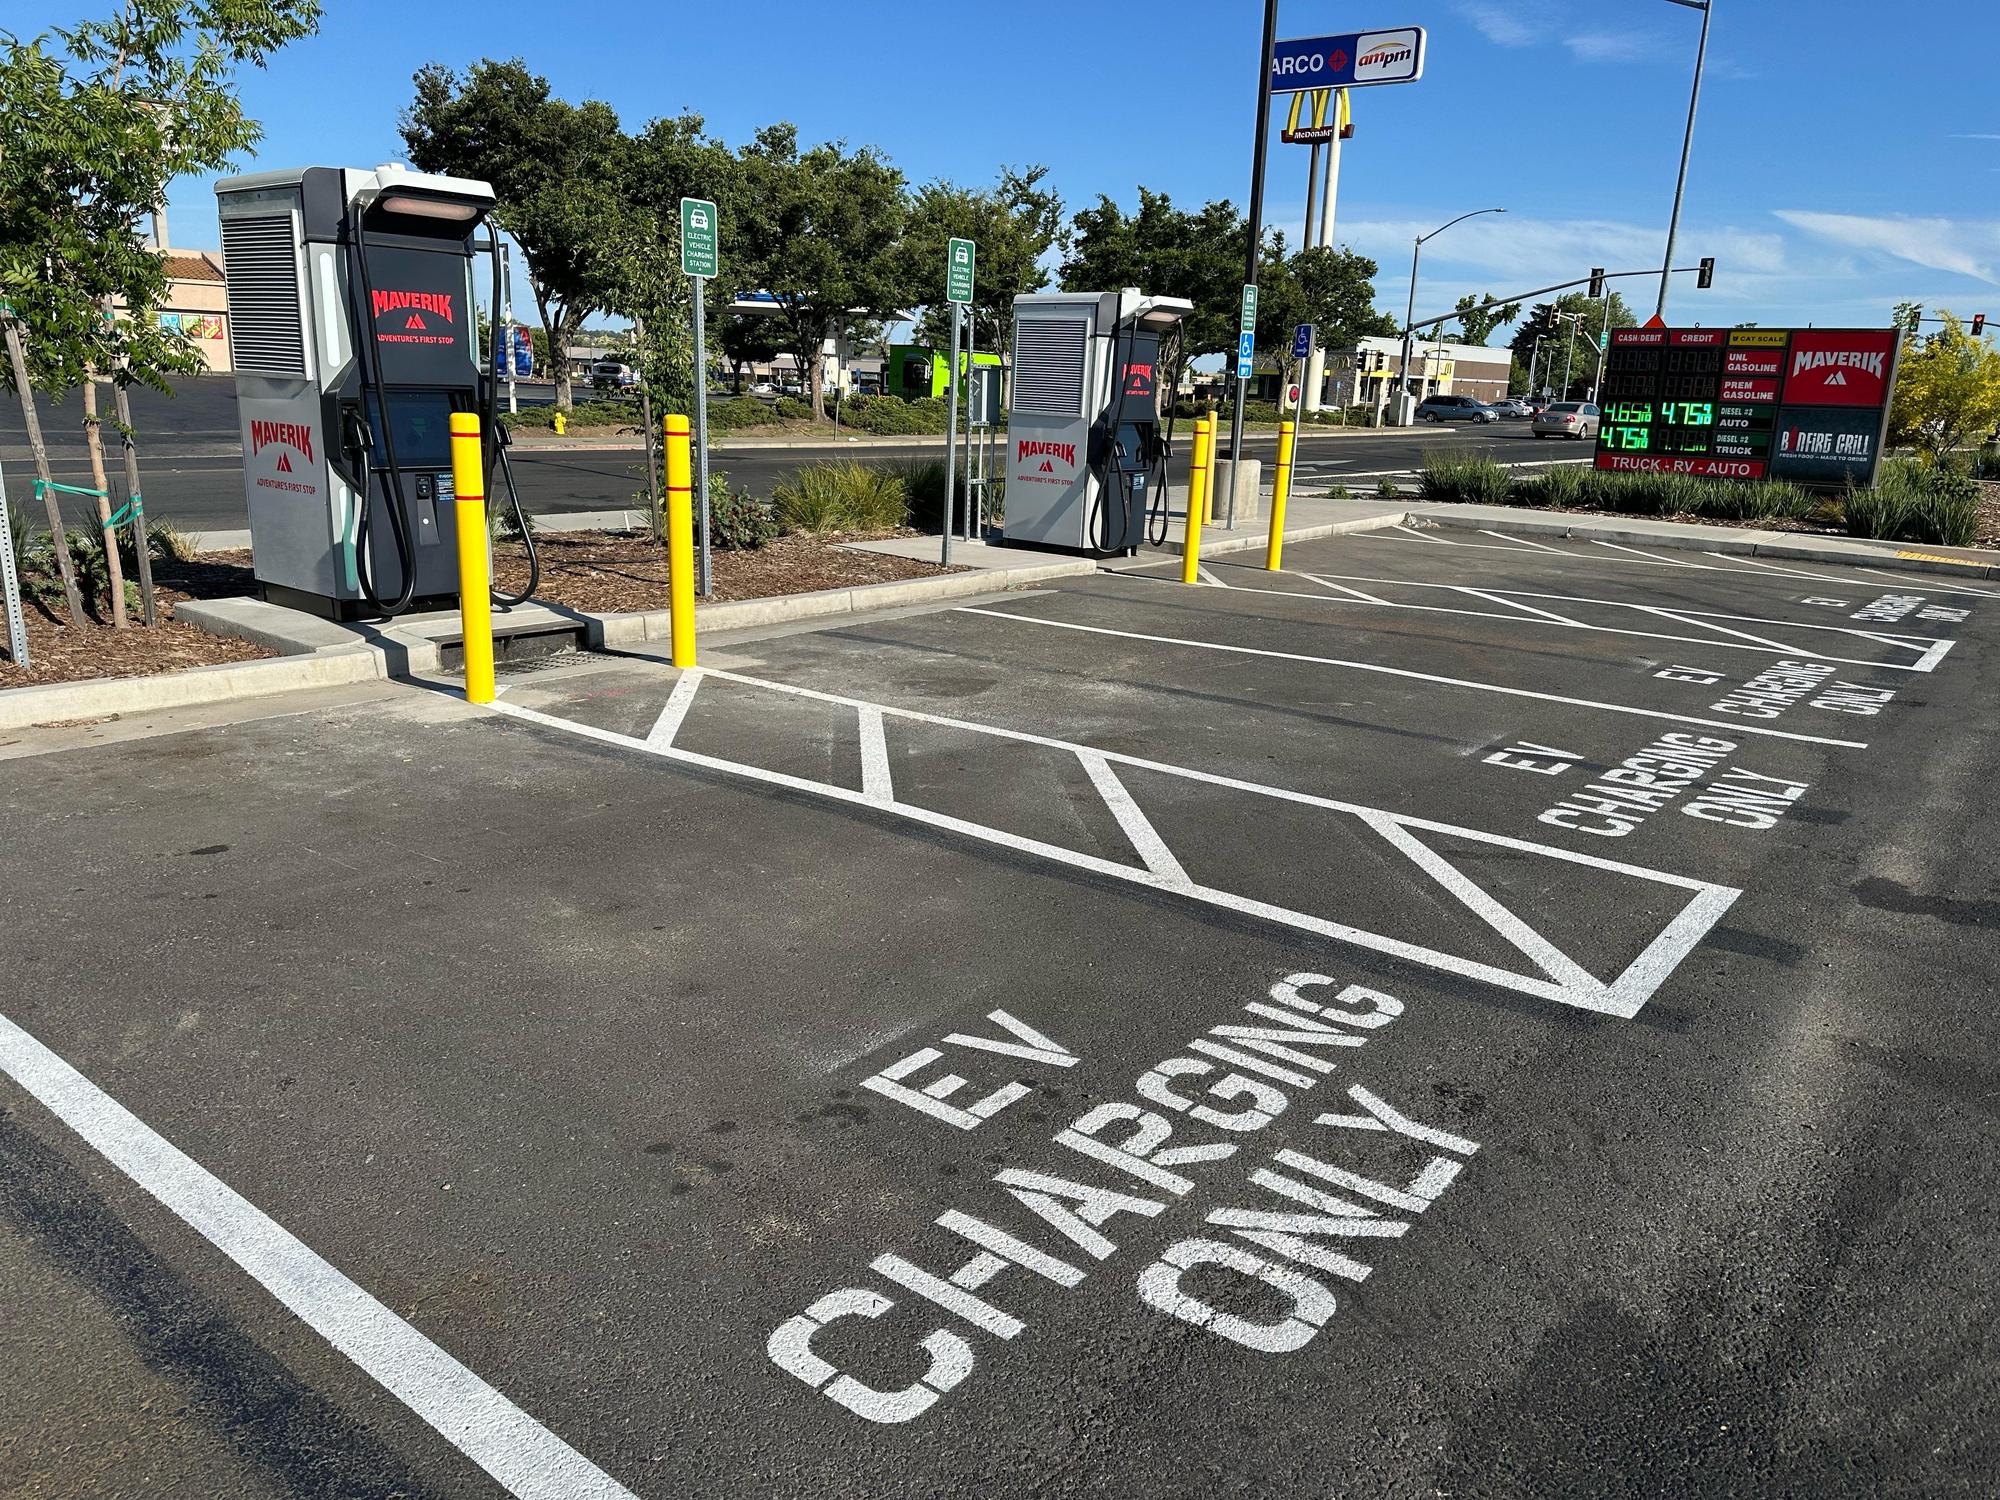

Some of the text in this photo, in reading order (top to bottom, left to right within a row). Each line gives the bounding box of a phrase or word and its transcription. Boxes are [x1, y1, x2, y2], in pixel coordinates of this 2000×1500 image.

[1272, 53, 1324, 75] ARCO
[1358, 49, 1411, 68] ampm
[1294, 129, 1333, 139] McDonald'
[688, 232, 712, 242] ELECTRIC
[689, 241, 711, 251] VEHICLE
[687, 250, 713, 259] CHARGING
[689, 260, 711, 268] STATION
[372, 290, 453, 324] MAVERIK
[420, 336, 437, 344] FIRST
[1681, 334, 1714, 342] CREDIT
[1728, 353, 1748, 361] UNL
[1792, 351, 1885, 380] MAVERIK
[1727, 363, 1777, 372] GASOLINE
[1724, 381, 1753, 389] PREM
[1723, 391, 1774, 400] GASOLINE
[1720, 407, 1753, 416] DIESEL #2
[1719, 418, 1749, 428] AUTO
[251, 420, 314, 466] MAVERIK
[1716, 434, 1738, 443] DIESEL
[1740, 435, 1749, 444] #2
[1018, 440, 1076, 468] MAVERIK
[1715, 445, 1752, 455] TRUCK
[1611, 456, 1661, 471] TRUCK
[1673, 460, 1695, 473] RV
[1706, 462, 1750, 476] AUTO
[257, 478, 316, 495] ADVENTURE'S FIRST STOP
[1653, 665, 1726, 685] EV
[1709, 660, 1837, 719] CHARGING
[1808, 680, 1896, 715] ONLY
[1482, 741, 1585, 775] EV
[1537, 732, 1738, 837] CHARGING
[1681, 766, 1809, 830] ONLY
[860, 1008, 1080, 1131] EV
[766, 972, 1405, 1424] CHARGING
[1137, 1084, 1481, 1353] ONLY
